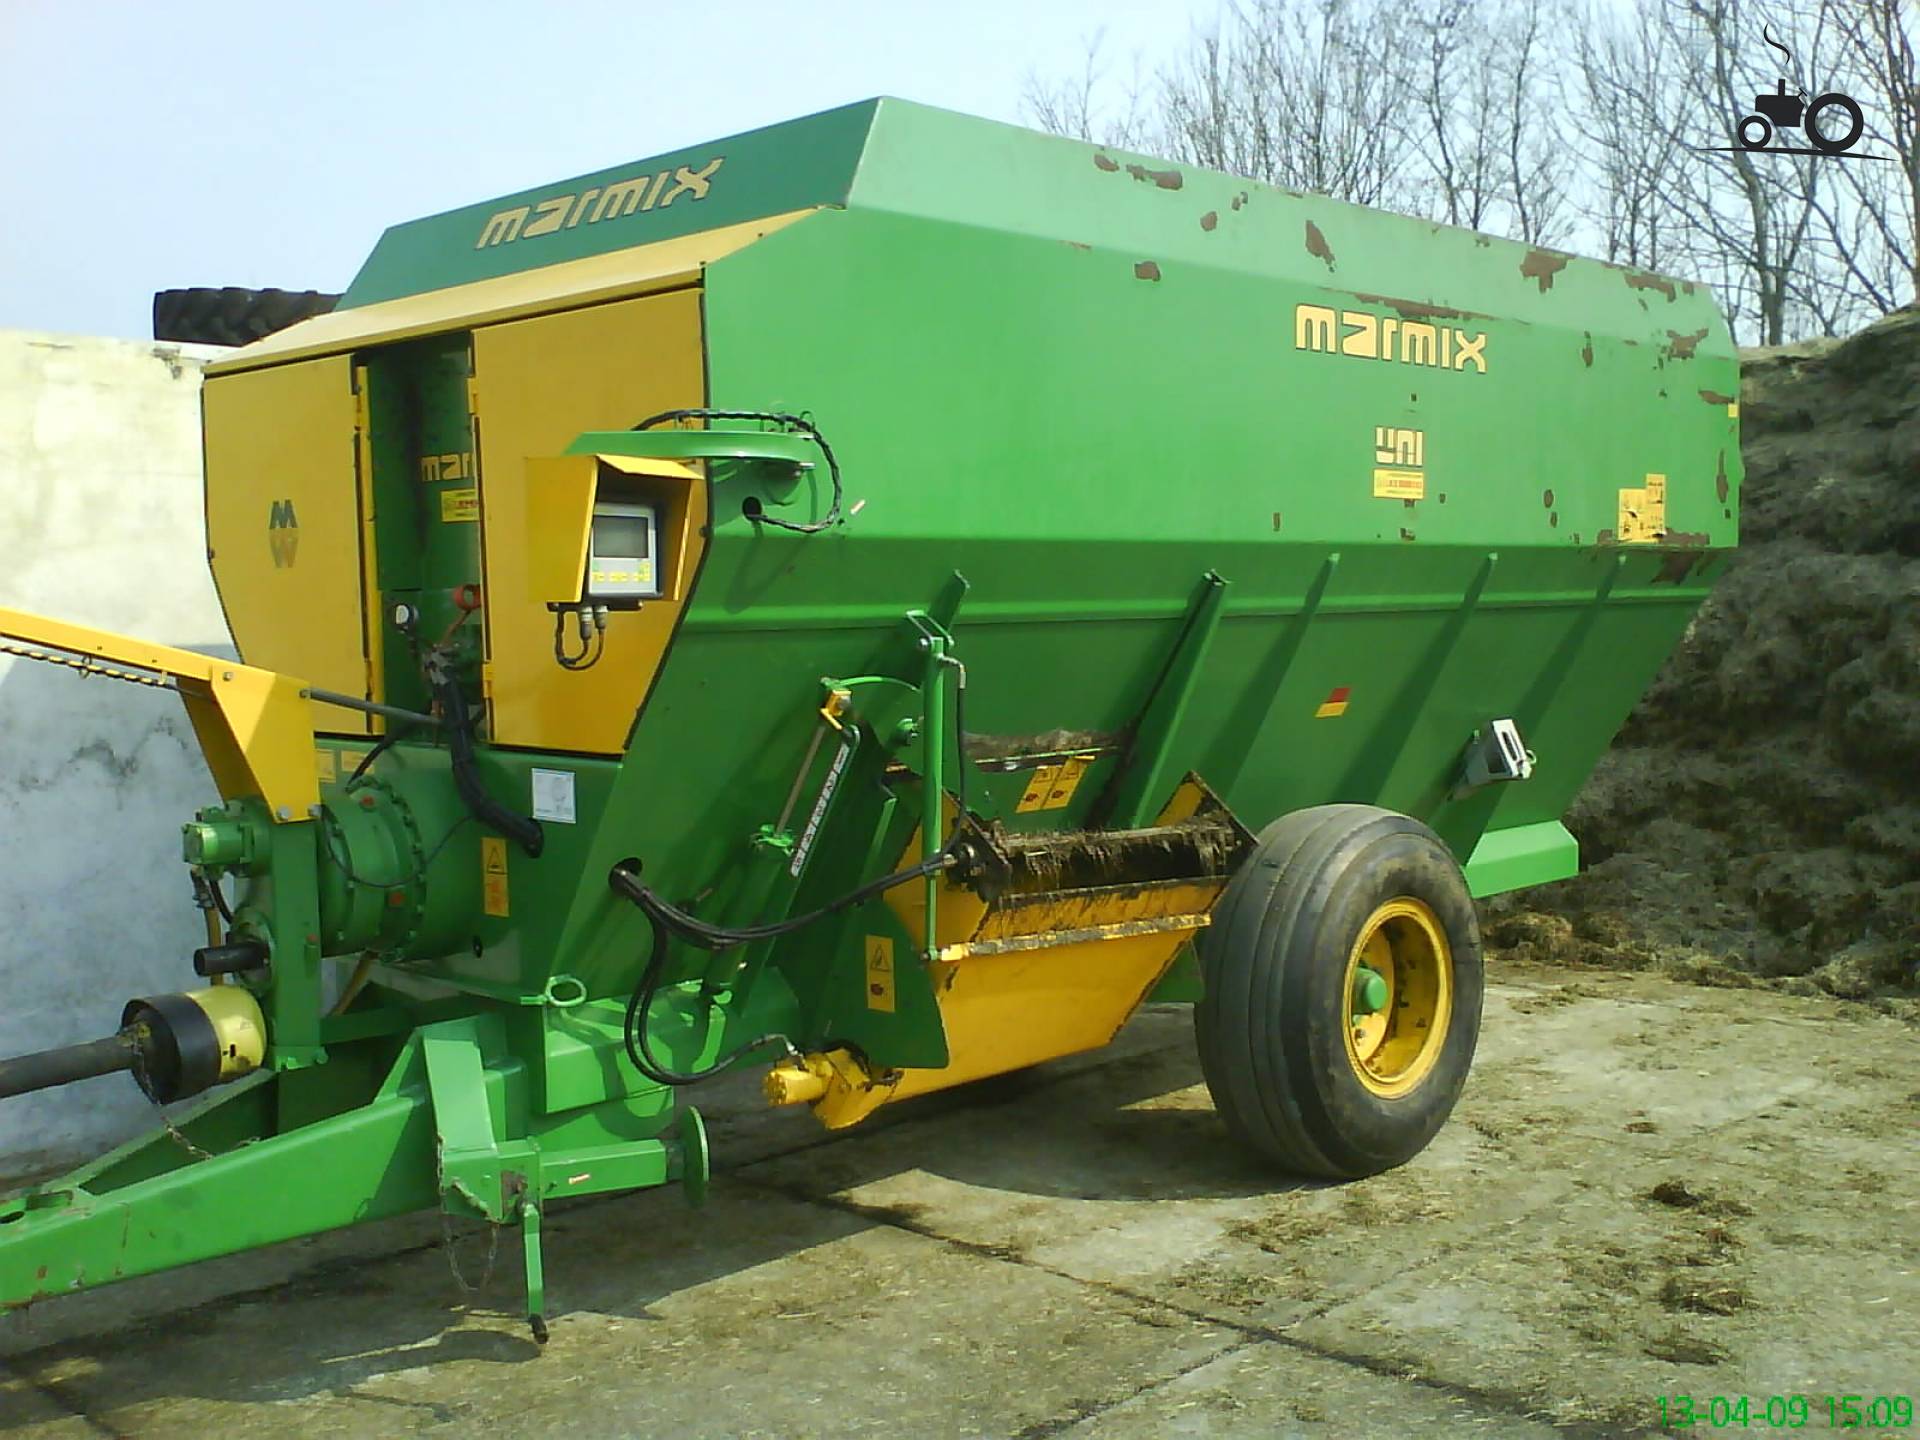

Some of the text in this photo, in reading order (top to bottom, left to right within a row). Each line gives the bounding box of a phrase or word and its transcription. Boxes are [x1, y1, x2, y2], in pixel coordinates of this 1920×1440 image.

[475, 157, 725, 249] marmix
[1296, 304, 1486, 374] marmix
[421, 452, 475, 481] mar
